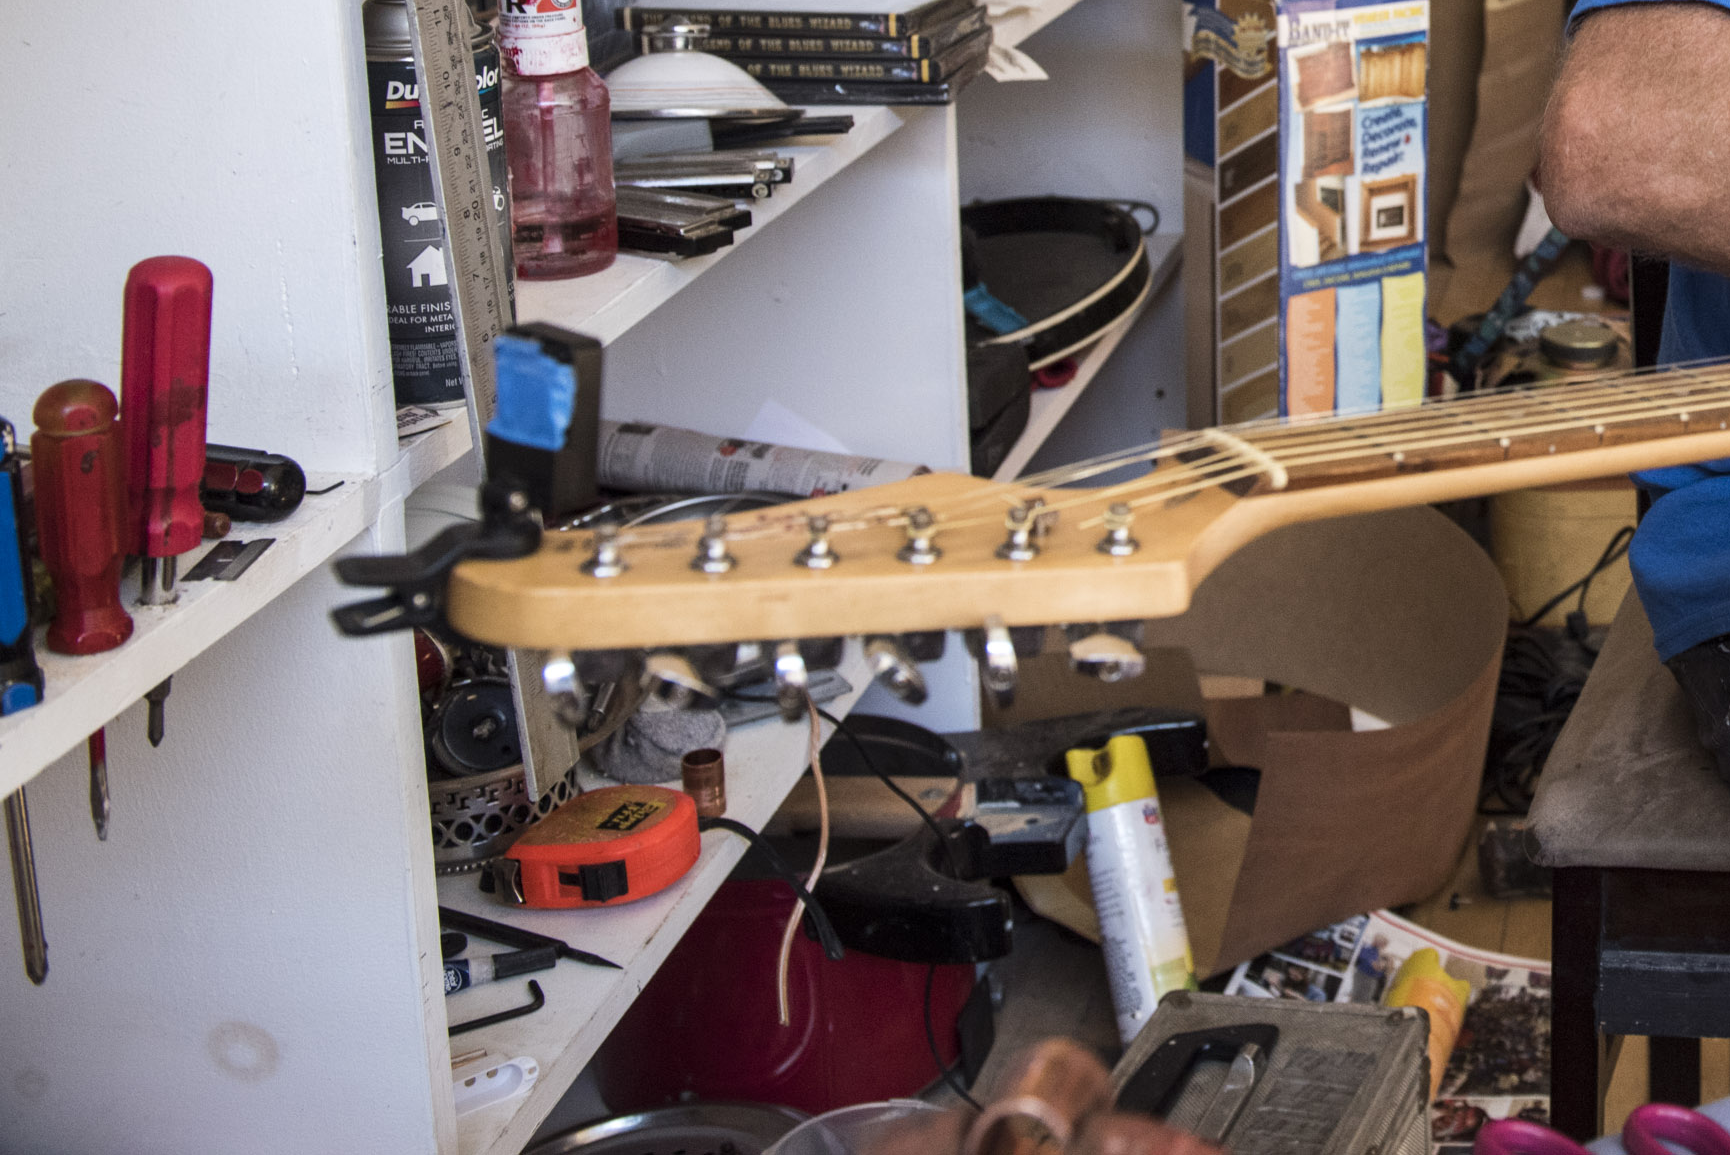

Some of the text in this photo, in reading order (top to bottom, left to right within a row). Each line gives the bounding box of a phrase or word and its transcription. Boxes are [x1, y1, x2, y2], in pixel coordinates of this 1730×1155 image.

[769, 16, 803, 30] BLUES
[809, 17, 852, 30] WIZARD
[788, 39, 825, 52] BLUES
[830, 39, 875, 53] WIZARD
[798, 64, 834, 78] BLUES
[840, 64, 885, 78] WIZARD
[387, 301, 451, 315] RABLE FINIS
[410, 316, 428, 324] FOR
[430, 314, 454, 323] META
[445, 378, 457, 388] Net
